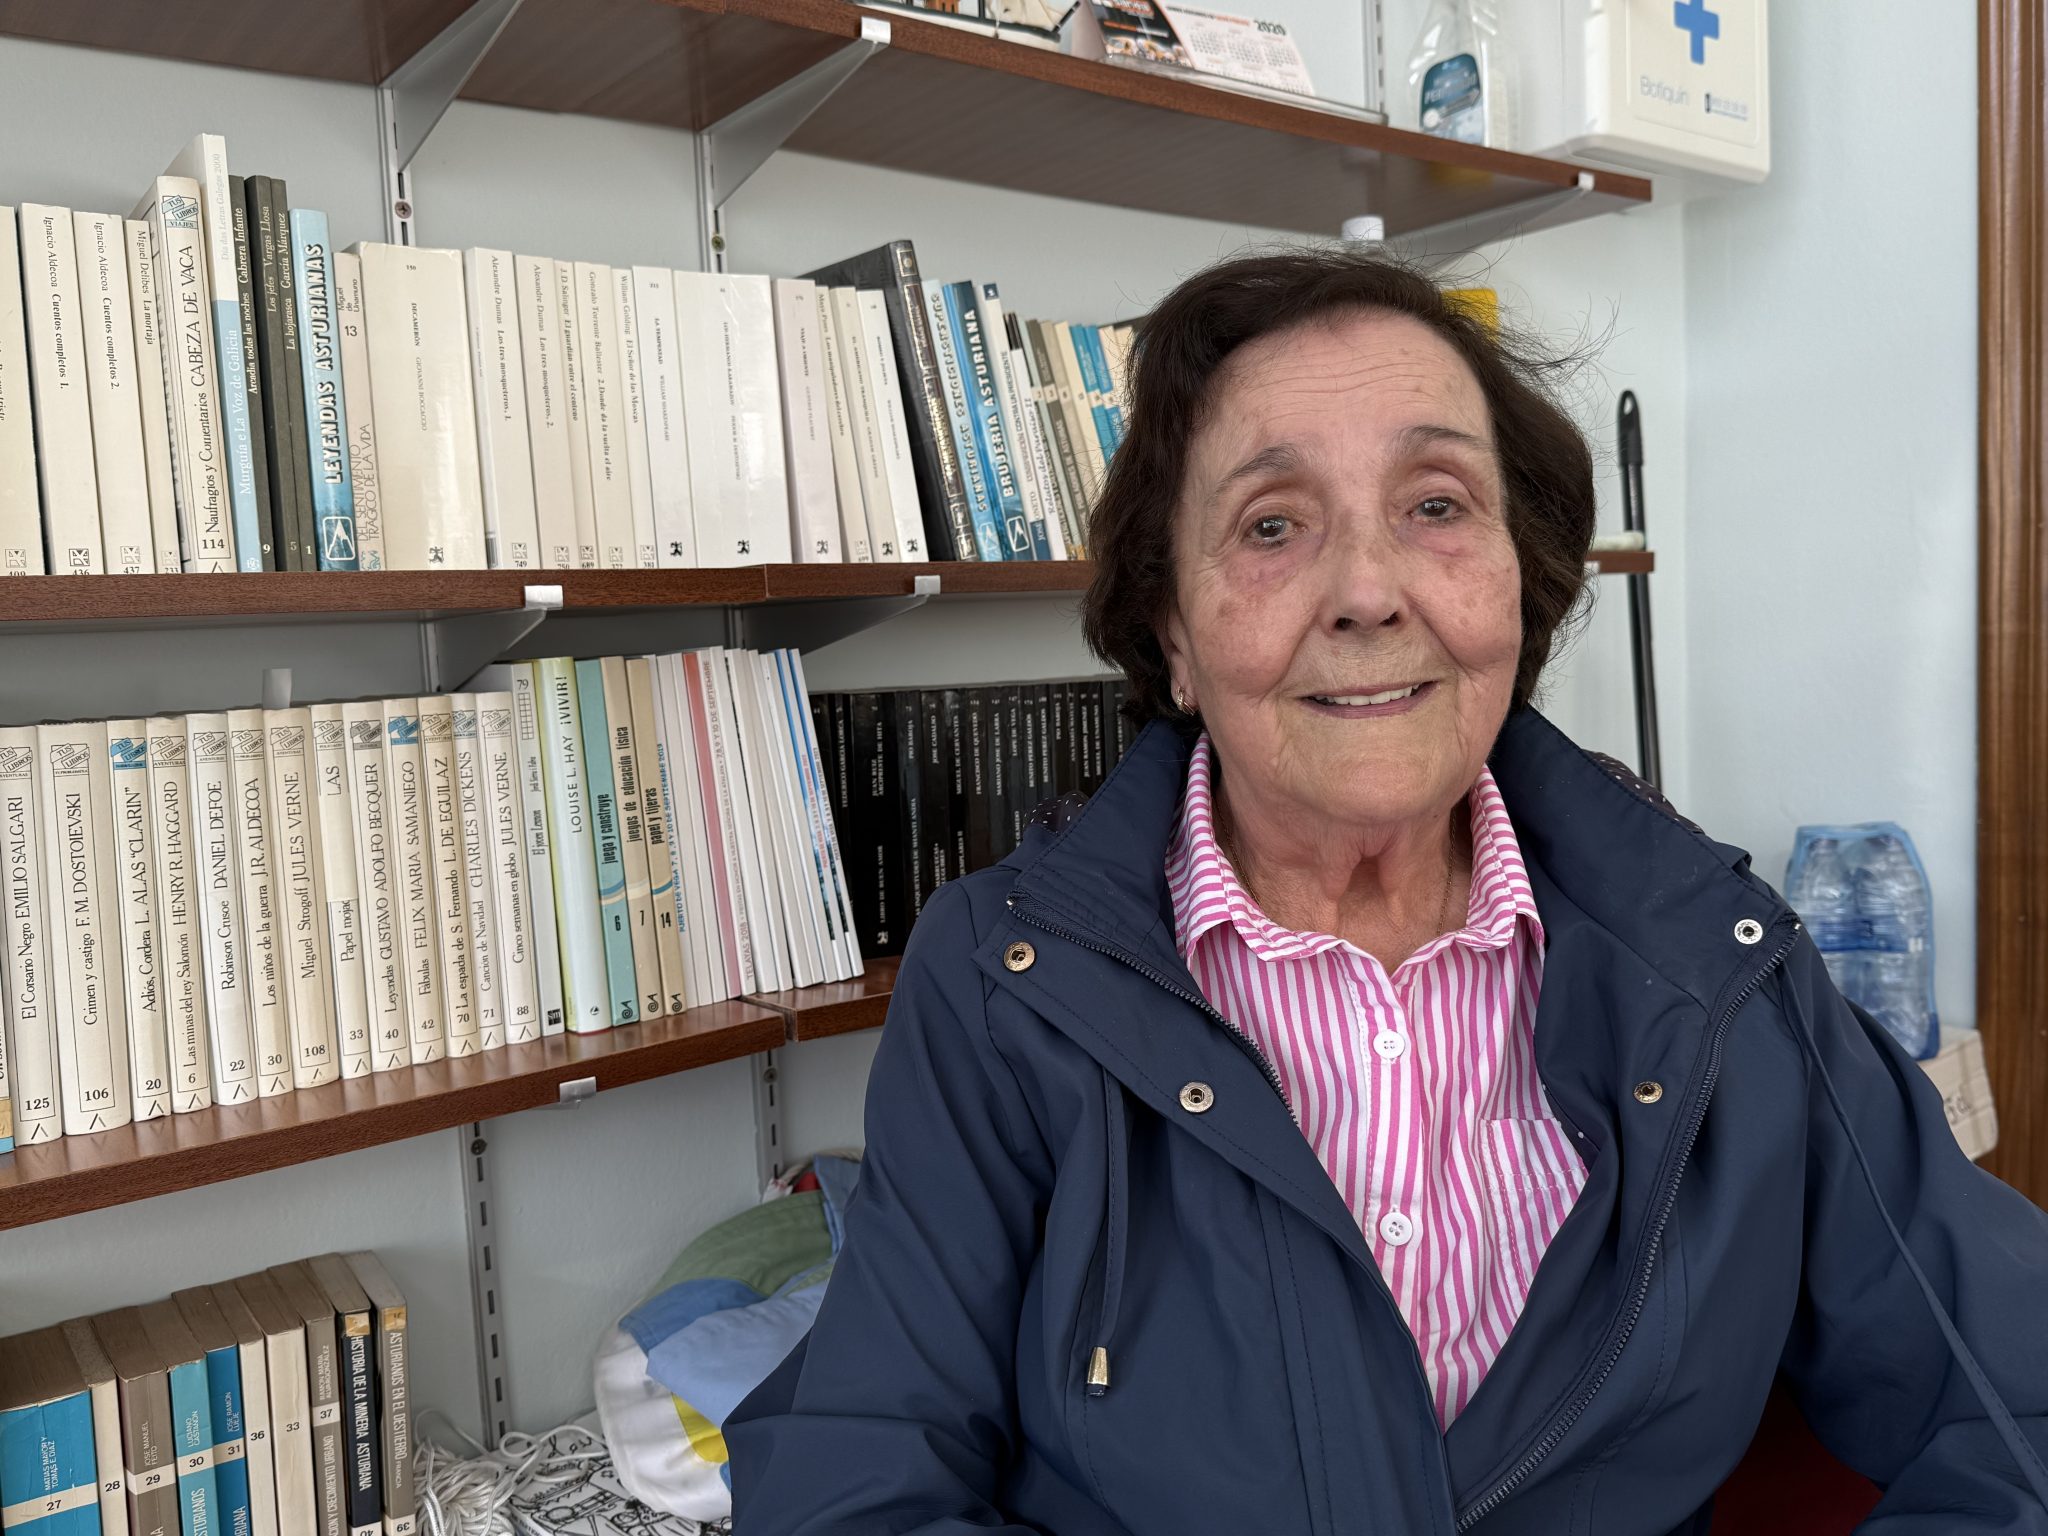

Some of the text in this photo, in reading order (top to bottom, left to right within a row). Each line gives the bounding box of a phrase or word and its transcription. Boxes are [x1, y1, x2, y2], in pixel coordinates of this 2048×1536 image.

[1254, 20, 1286, 36] 2020
[169, 197, 182, 208] TUS
[176, 206, 198, 219] LIBROS
[45, 217, 54, 248] Ignacio
[94, 222, 104, 253] Ignacio
[49, 251, 57, 287] Aldecoa
[99, 256, 108, 290] Aldecoa
[52, 294, 61, 330] Cuentos
[103, 297, 112, 334] Cuentos
[234, 207, 258, 395] Arcadia todas las noches Cabrera Infante
[345, 326, 357, 336] 13
[56, 333, 66, 378] completos
[107, 336, 117, 379] completos
[305, 243, 343, 484] LEYENDAS ASTURIANAS
[179, 246, 220, 533] Naufragios y Comentarios CABEZA DE VACA
[931, 293, 964, 417] SUPERSTICIONES
[960, 425, 988, 513] ASTURIANAS
[964, 309, 1015, 497] BRUJERIA ASTURIANA
[202, 539, 225, 549] 114
[517, 679, 528, 689] 79
[556, 675, 582, 833] LOUISE L. HAY ¡VIVIR!
[326, 766, 341, 796] LAS
[459, 752, 476, 812] DICKENS
[617, 726, 643, 842] juegos de educación física
[402, 761, 419, 845] SAMANIEGO
[645, 788, 661, 815] tijeras
[66, 793, 88, 893] DOSTOIEVSKI
[597, 793, 619, 865] juega y construye
[648, 824, 665, 845] papel
[466, 819, 483, 888] CHARLES
[494, 752, 524, 963] Cinco semanas en globo JULES VERNE
[131, 861, 148, 905] ALAS
[208, 781, 236, 990] Robinson Crusoe DANIEL DEFOE
[284, 772, 316, 979] Miguel Strogoff JULES VERNE
[365, 763, 399, 1012] Leyendas GUSTAVO ADOLFO BECQUER
[408, 851, 424, 901] MARIA
[435, 757, 468, 1009] La espada de S. Fernando L. DE EGUILAZ
[8, 797, 36, 1019] El Corsario Negro EMILIO SALGARI
[75, 897, 89, 914] M.
[135, 910, 150, 924] L.
[473, 900, 487, 938] Navidad
[640, 910, 645, 926] 7
[661, 912, 671, 929] 14
[76, 917, 90, 927] F.
[412, 906, 428, 949] FELIX
[615, 915, 621, 931] 6
[78, 934, 95, 970] castigo
[137, 930, 154, 974] Cordera
[256, 885, 276, 1006] Los niños de la guerra
[339, 932, 357, 962] Papel
[477, 941, 488, 950] de
[170, 874, 197, 1068] Las minas del rey Salomón HENRY
[84, 985, 98, 1025] Crimen
[141, 976, 156, 1012] Adiós,
[421, 1019, 434, 1029] 42
[457, 1013, 469, 1023] 70
[483, 1008, 495, 1018] 71
[517, 1006, 529, 1015] 88
[350, 1029, 363, 1040] 33
[385, 1029, 398, 1038] 40
[230, 1060, 245, 1071] 22
[267, 1054, 282, 1065] 30
[305, 1045, 325, 1056] 108
[146, 1079, 161, 1090] 20
[188, 1073, 196, 1083] 6
[25, 1098, 50, 1111] 125
[85, 1088, 109, 1101] 106
[390, 1332, 405, 1385] ASTURIANOS
[392, 1387, 405, 1400] EN
[393, 1401, 405, 1412] EL
[286, 1422, 300, 1432] 33
[321, 1409, 332, 1419] 37
[351, 1336, 372, 1491] HISTORIA DE LA MINERIA ASTURIANA
[228, 1445, 241, 1455] 31
[250, 1431, 265, 1441] 36
[393, 1413, 407, 1460] DESTIERRO
[189, 1457, 204, 1467] 30
[105, 1481, 120, 1492] 28
[146, 1475, 160, 1486] 29
[47, 1500, 62, 1511] 27
[396, 1522, 410, 1532] 39
